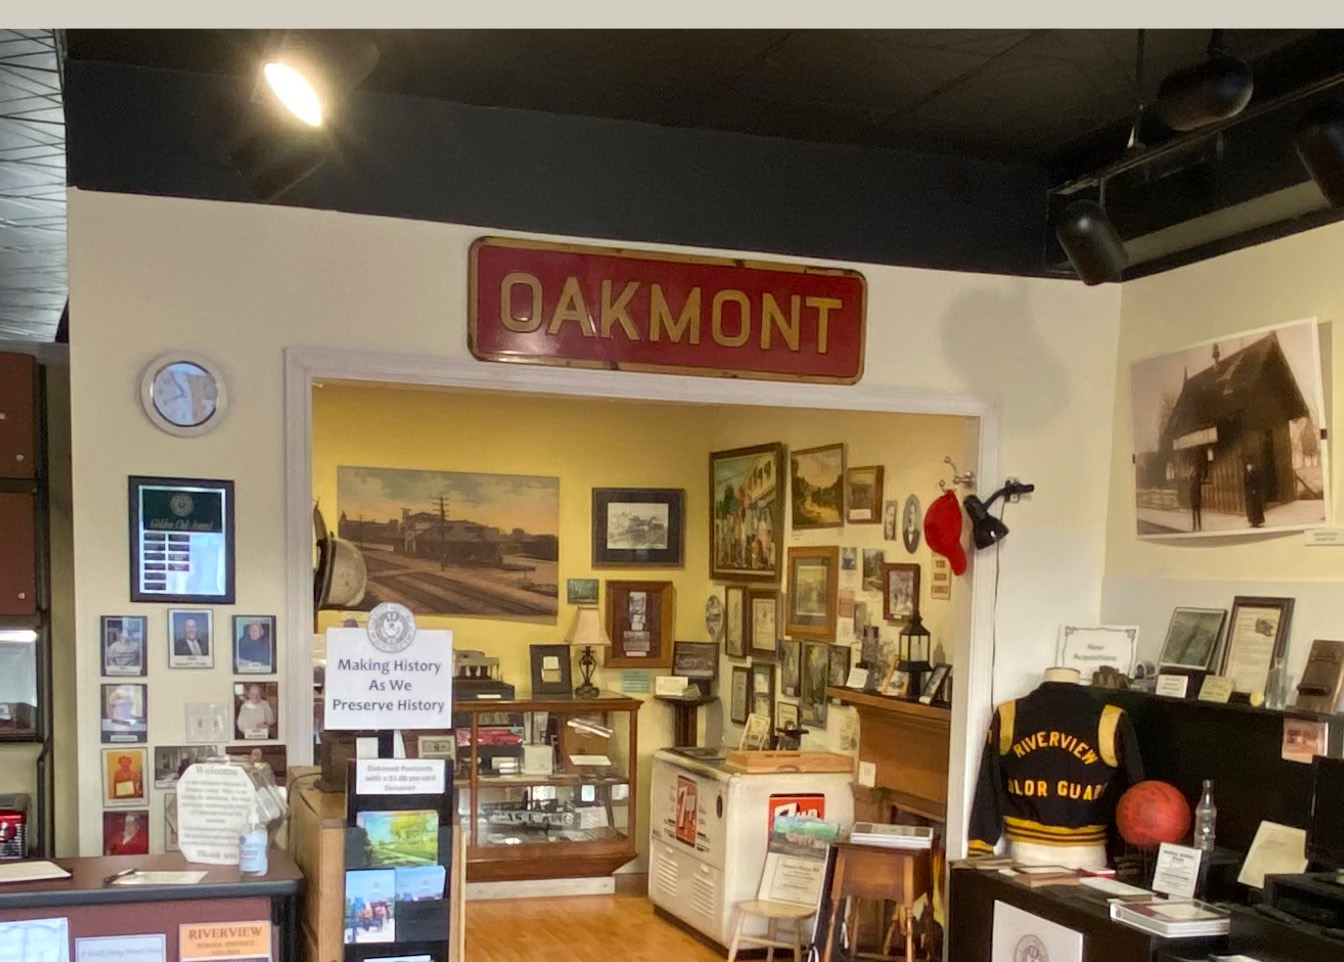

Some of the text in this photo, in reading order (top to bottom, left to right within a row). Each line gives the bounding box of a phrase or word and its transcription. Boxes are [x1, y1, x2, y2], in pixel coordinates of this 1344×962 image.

[500, 272, 844, 354] OAKMONT
[1073, 653, 1117, 663] Acquisitions
[337, 658, 442, 675] Making History
[368, 679, 413, 691] As We
[332, 699, 445, 713] Preserve History
[1013, 731, 1098, 765] RIVERVIEW
[196, 765, 239, 776] Welcome
[188, 926, 263, 940] RIVERVIEW
